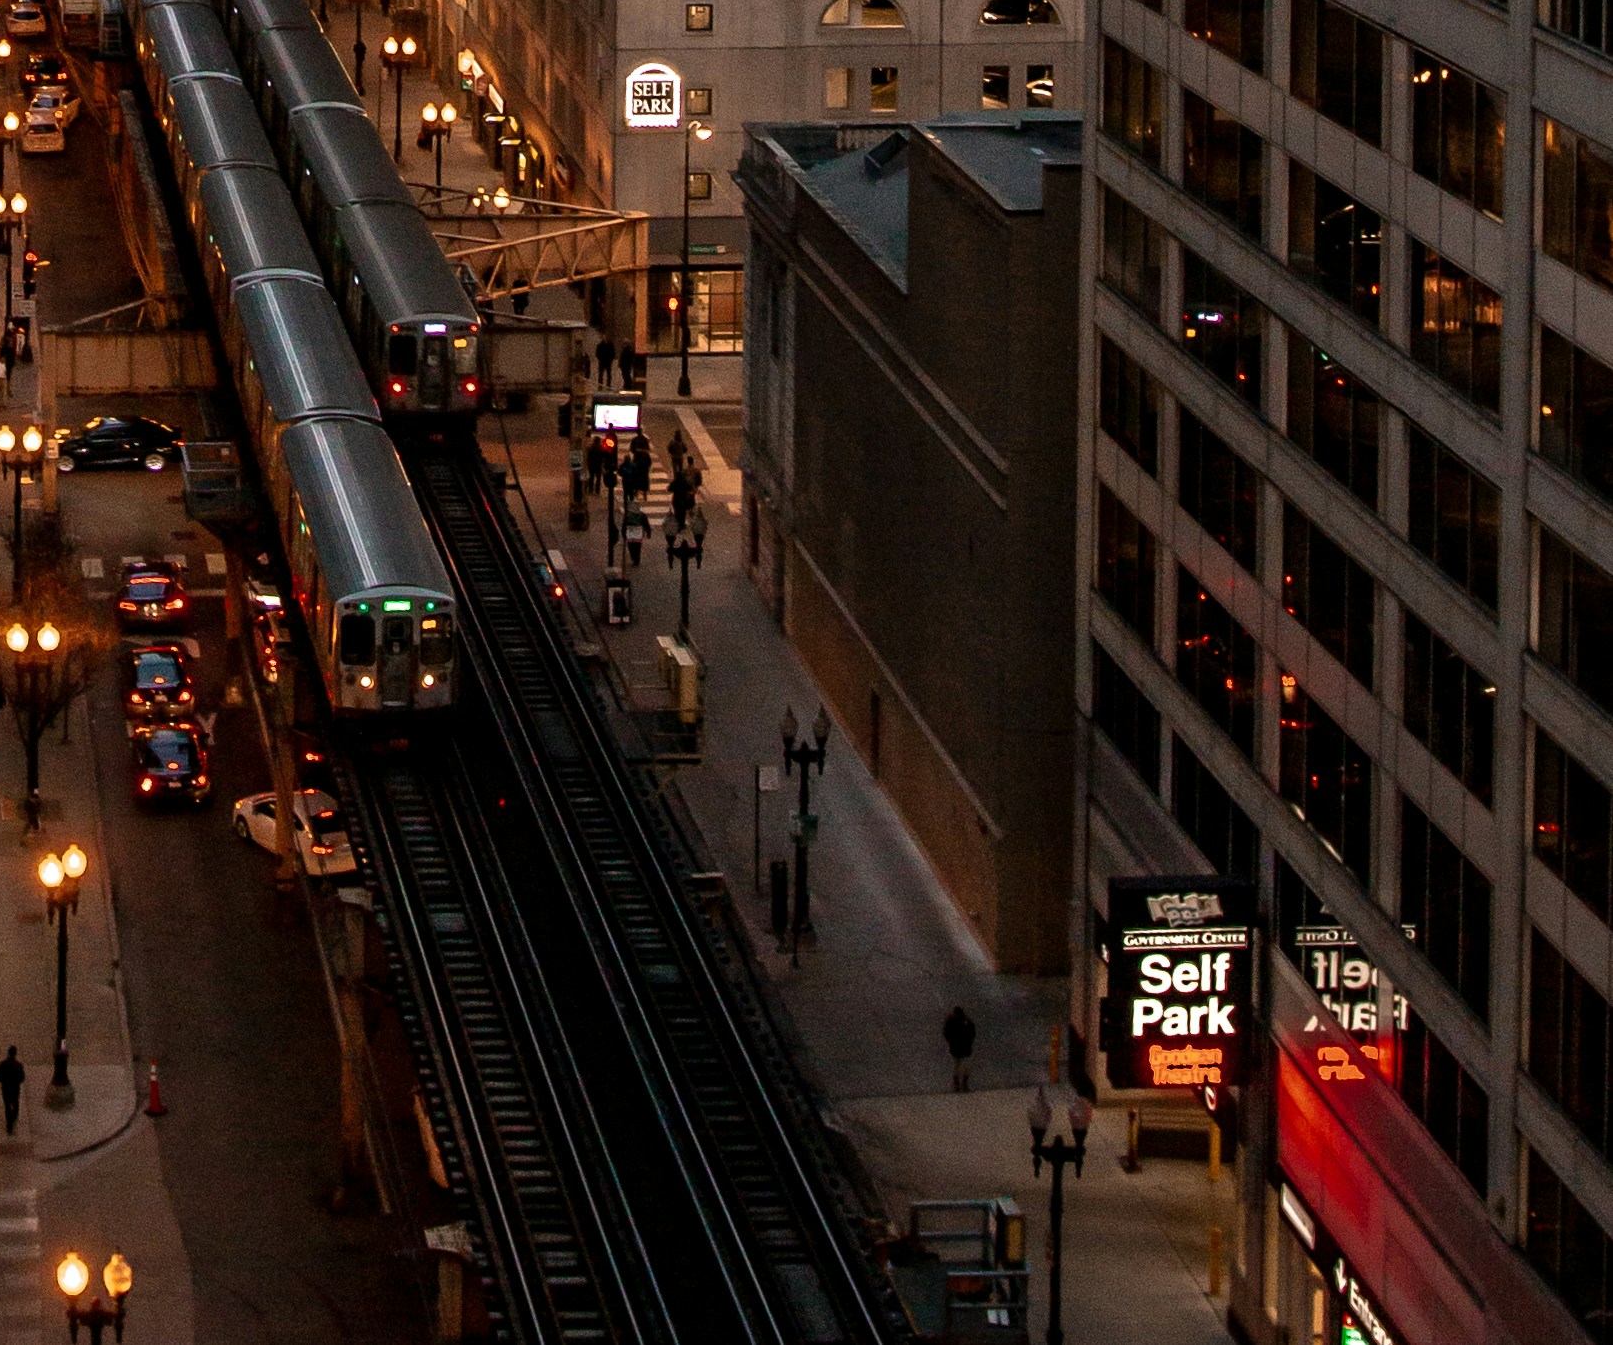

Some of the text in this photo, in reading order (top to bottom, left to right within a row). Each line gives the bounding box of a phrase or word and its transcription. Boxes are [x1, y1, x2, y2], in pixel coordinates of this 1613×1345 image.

[633, 82, 672, 97] SELF
[633, 98, 672, 113] PARK
[1139, 952, 1231, 994] Self
[1132, 996, 1236, 1037] Park
